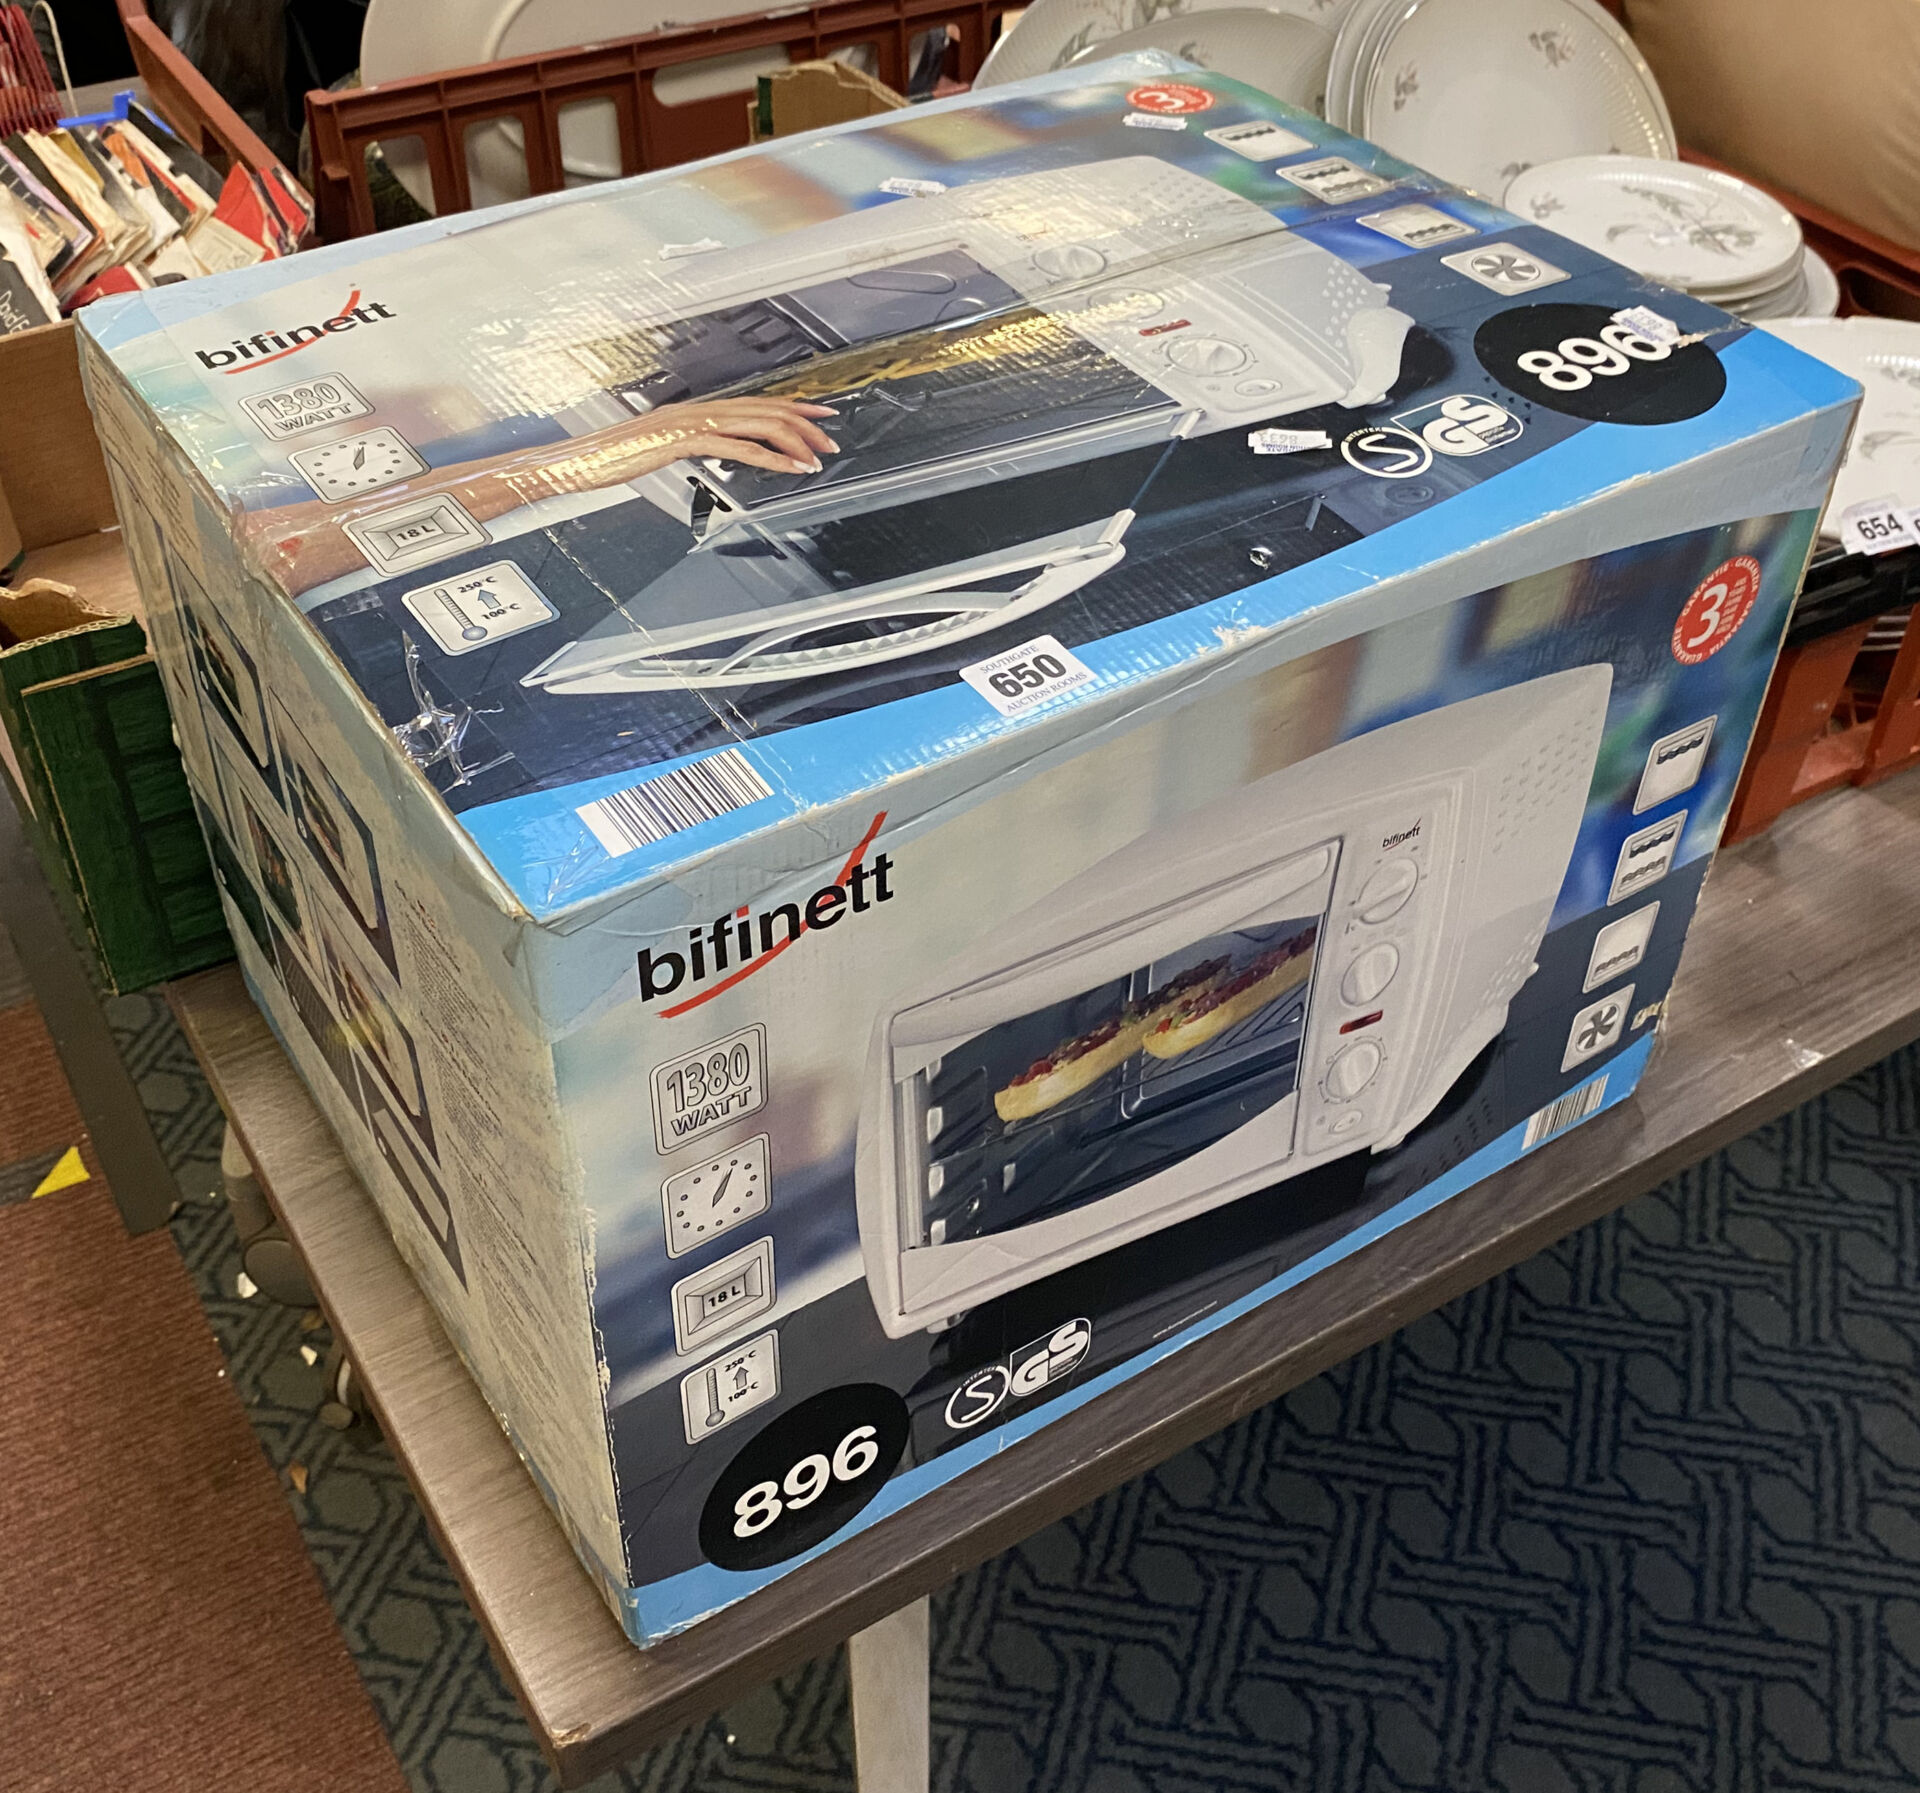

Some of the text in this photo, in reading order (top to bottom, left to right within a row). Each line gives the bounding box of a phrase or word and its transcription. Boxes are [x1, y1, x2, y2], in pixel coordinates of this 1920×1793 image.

[1139, 91, 1185, 110] 3
[194, 302, 397, 369] bifinett
[1517, 324, 1672, 391] 896
[257, 383, 341, 420] 1380
[274, 402, 351, 431] WATT
[1422, 397, 1508, 453] GS
[396, 525, 436, 541] 18 L
[1857, 514, 1904, 540] 654
[457, 576, 498, 593] 250°C
[482, 602, 522, 620] 100°C
[1687, 583, 1728, 648] 3
[980, 645, 1039, 674] SOUTHGATE
[988, 654, 1066, 698] 650
[1007, 672, 1088, 712] AUCTION ROOMS
[637, 853, 894, 1002] bifinett
[666, 1042, 750, 1113] 1380
[670, 1086, 752, 1136] WATT
[708, 1286, 741, 1308] 18 L
[724, 1350, 757, 1372] 250°C
[1011, 1321, 1089, 1394] GS
[728, 1381, 759, 1403] 100°C
[733, 1425, 879, 1538] 896
